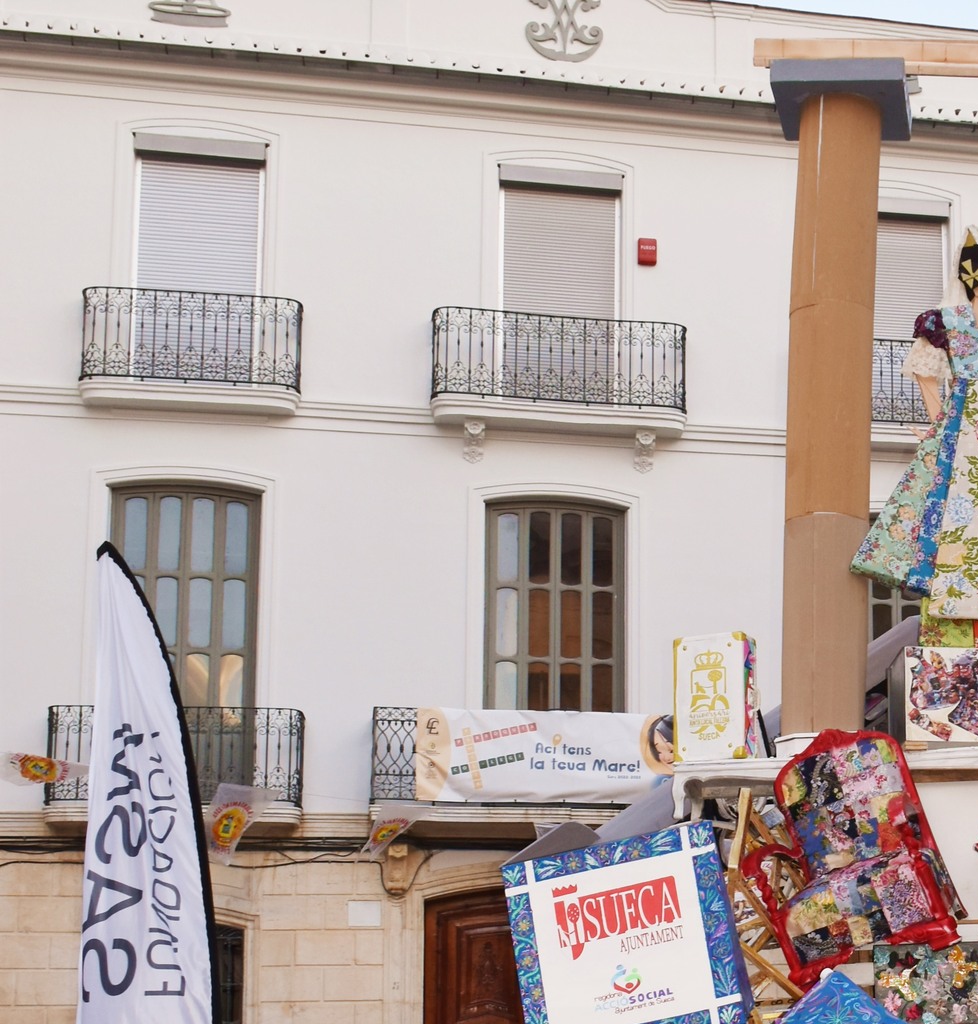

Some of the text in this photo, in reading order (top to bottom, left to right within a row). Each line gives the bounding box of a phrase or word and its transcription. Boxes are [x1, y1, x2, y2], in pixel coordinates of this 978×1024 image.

[698, 731, 721, 741] SUECA
[530, 757, 545, 770] la
[582, 881, 682, 942] SUECA
[619, 924, 684, 955] AJUNTAMENT
